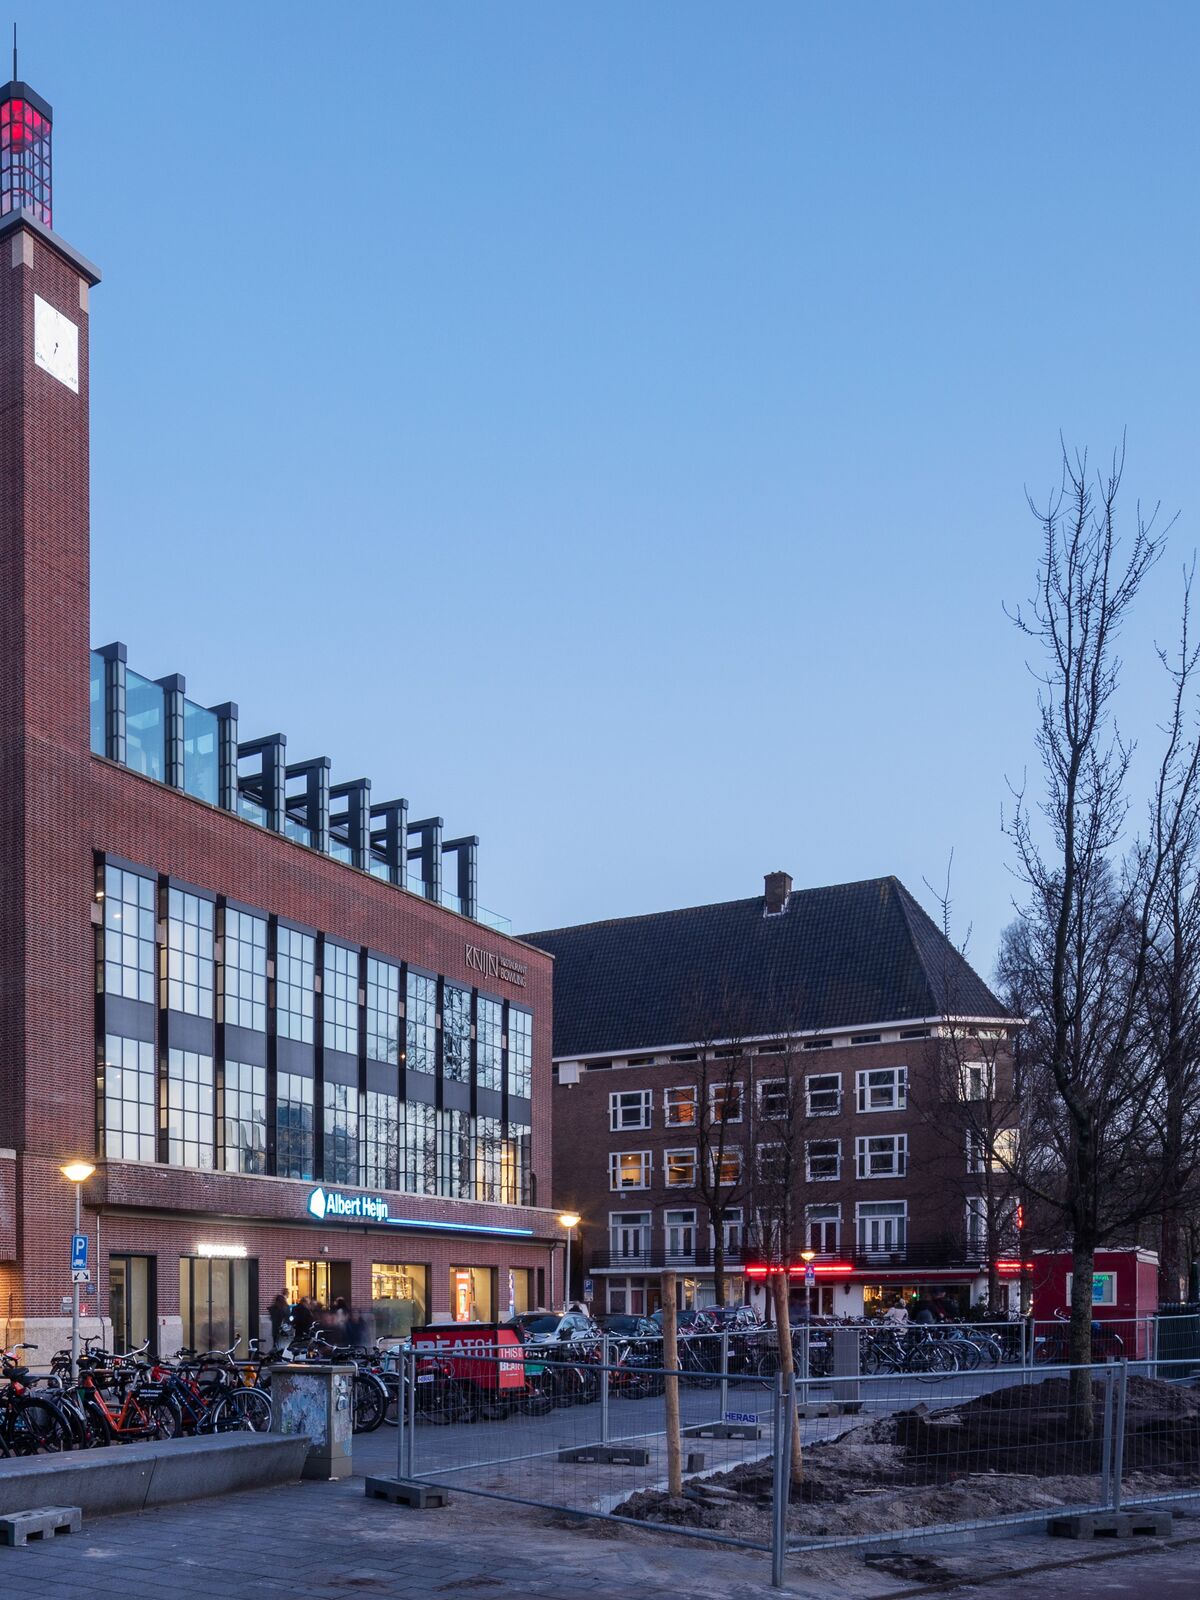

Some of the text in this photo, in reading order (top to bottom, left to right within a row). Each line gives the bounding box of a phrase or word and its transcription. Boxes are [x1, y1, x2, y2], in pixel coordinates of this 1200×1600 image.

[327, 1193, 388, 1221] Albert Heijn
[76, 1238, 85, 1256] P
